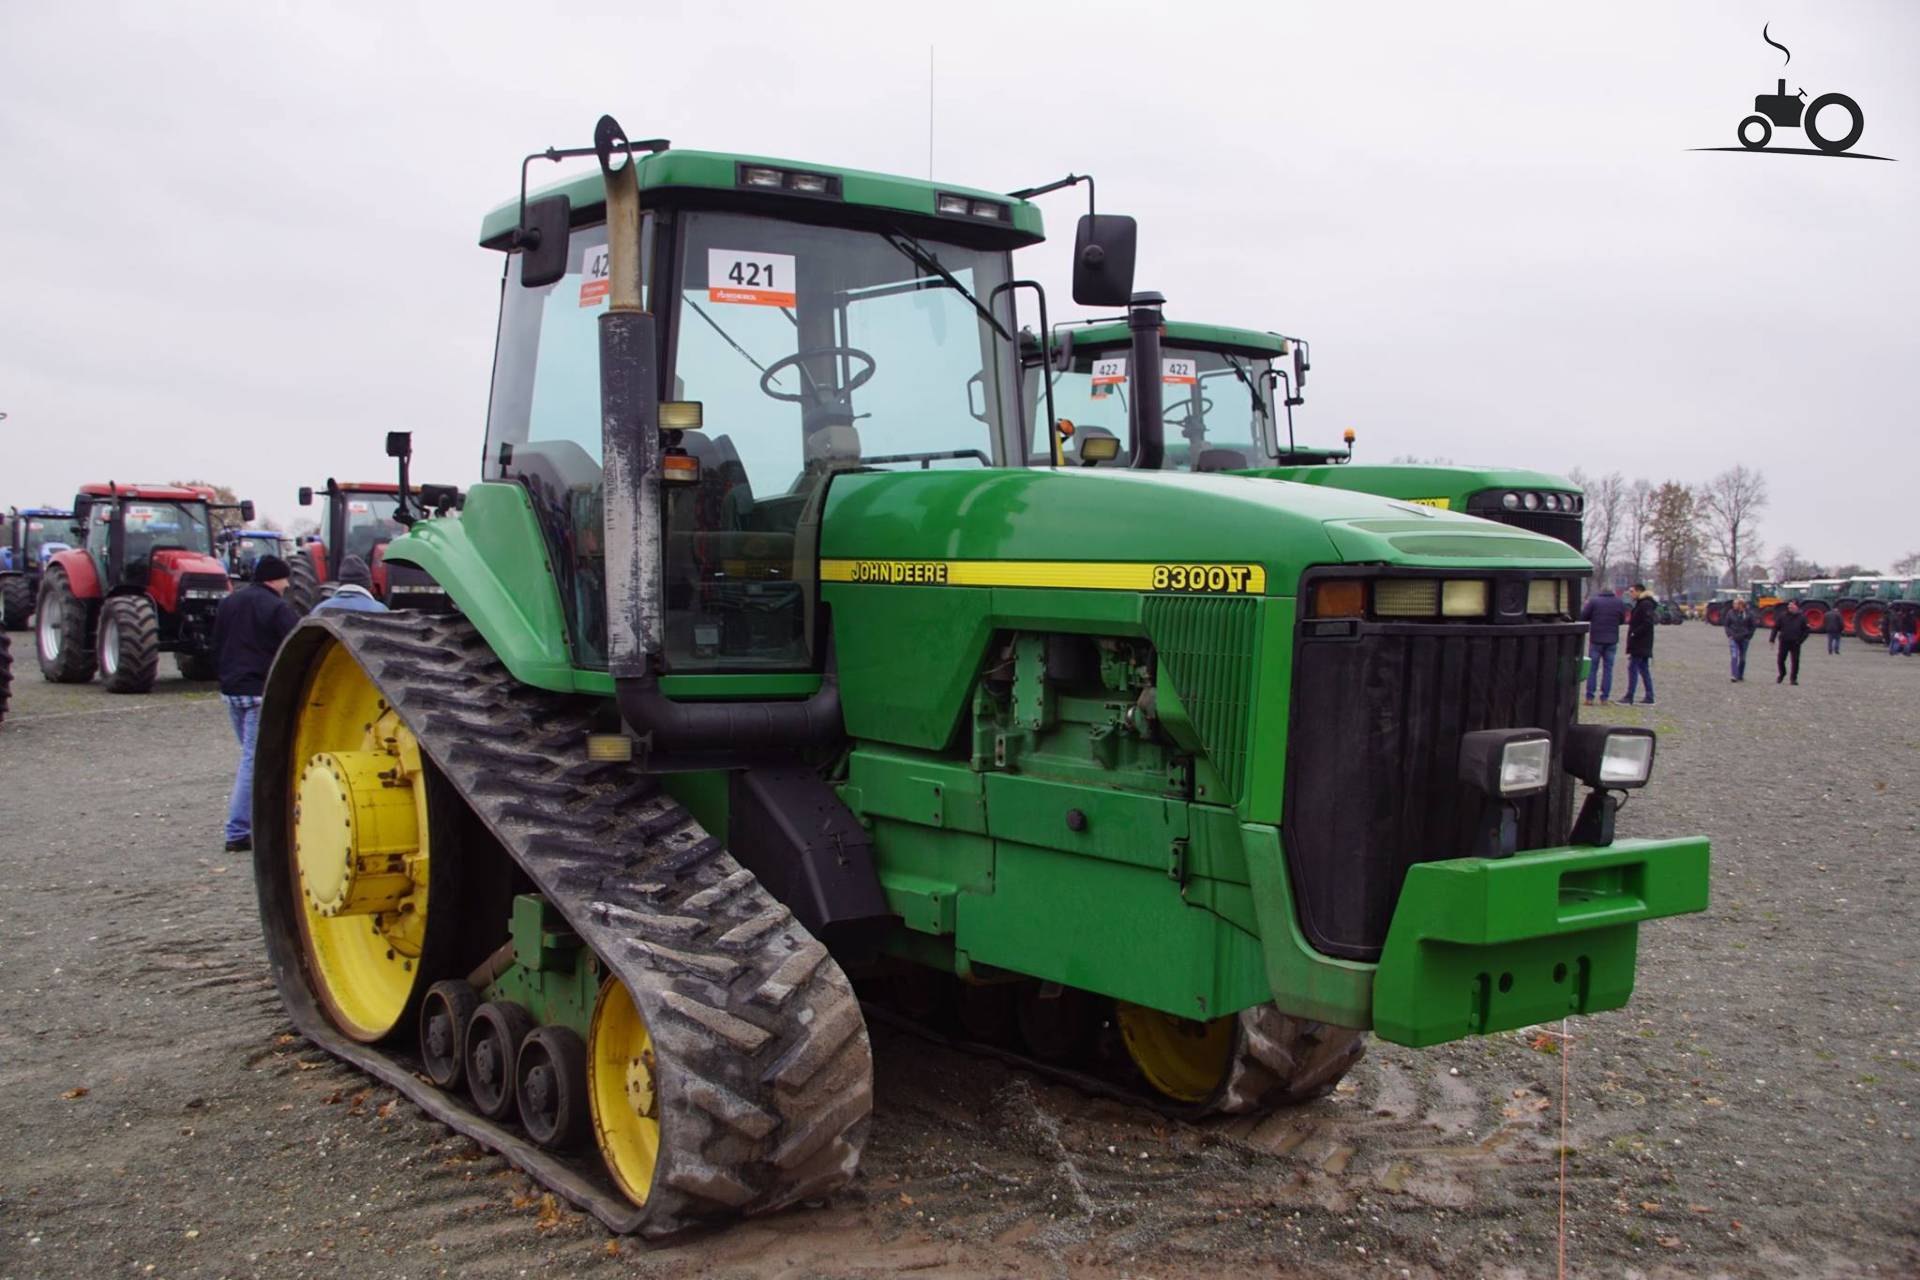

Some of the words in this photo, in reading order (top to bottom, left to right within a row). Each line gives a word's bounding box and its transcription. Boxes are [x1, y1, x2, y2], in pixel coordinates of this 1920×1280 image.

[591, 253, 609, 278] 42
[728, 261, 773, 287] 421
[1099, 364, 1118, 375] 422
[1169, 363, 1188, 375] 422
[852, 561, 891, 582] JOHN
[894, 562, 948, 584] DEERE
[1153, 565, 1252, 592] 8300T
